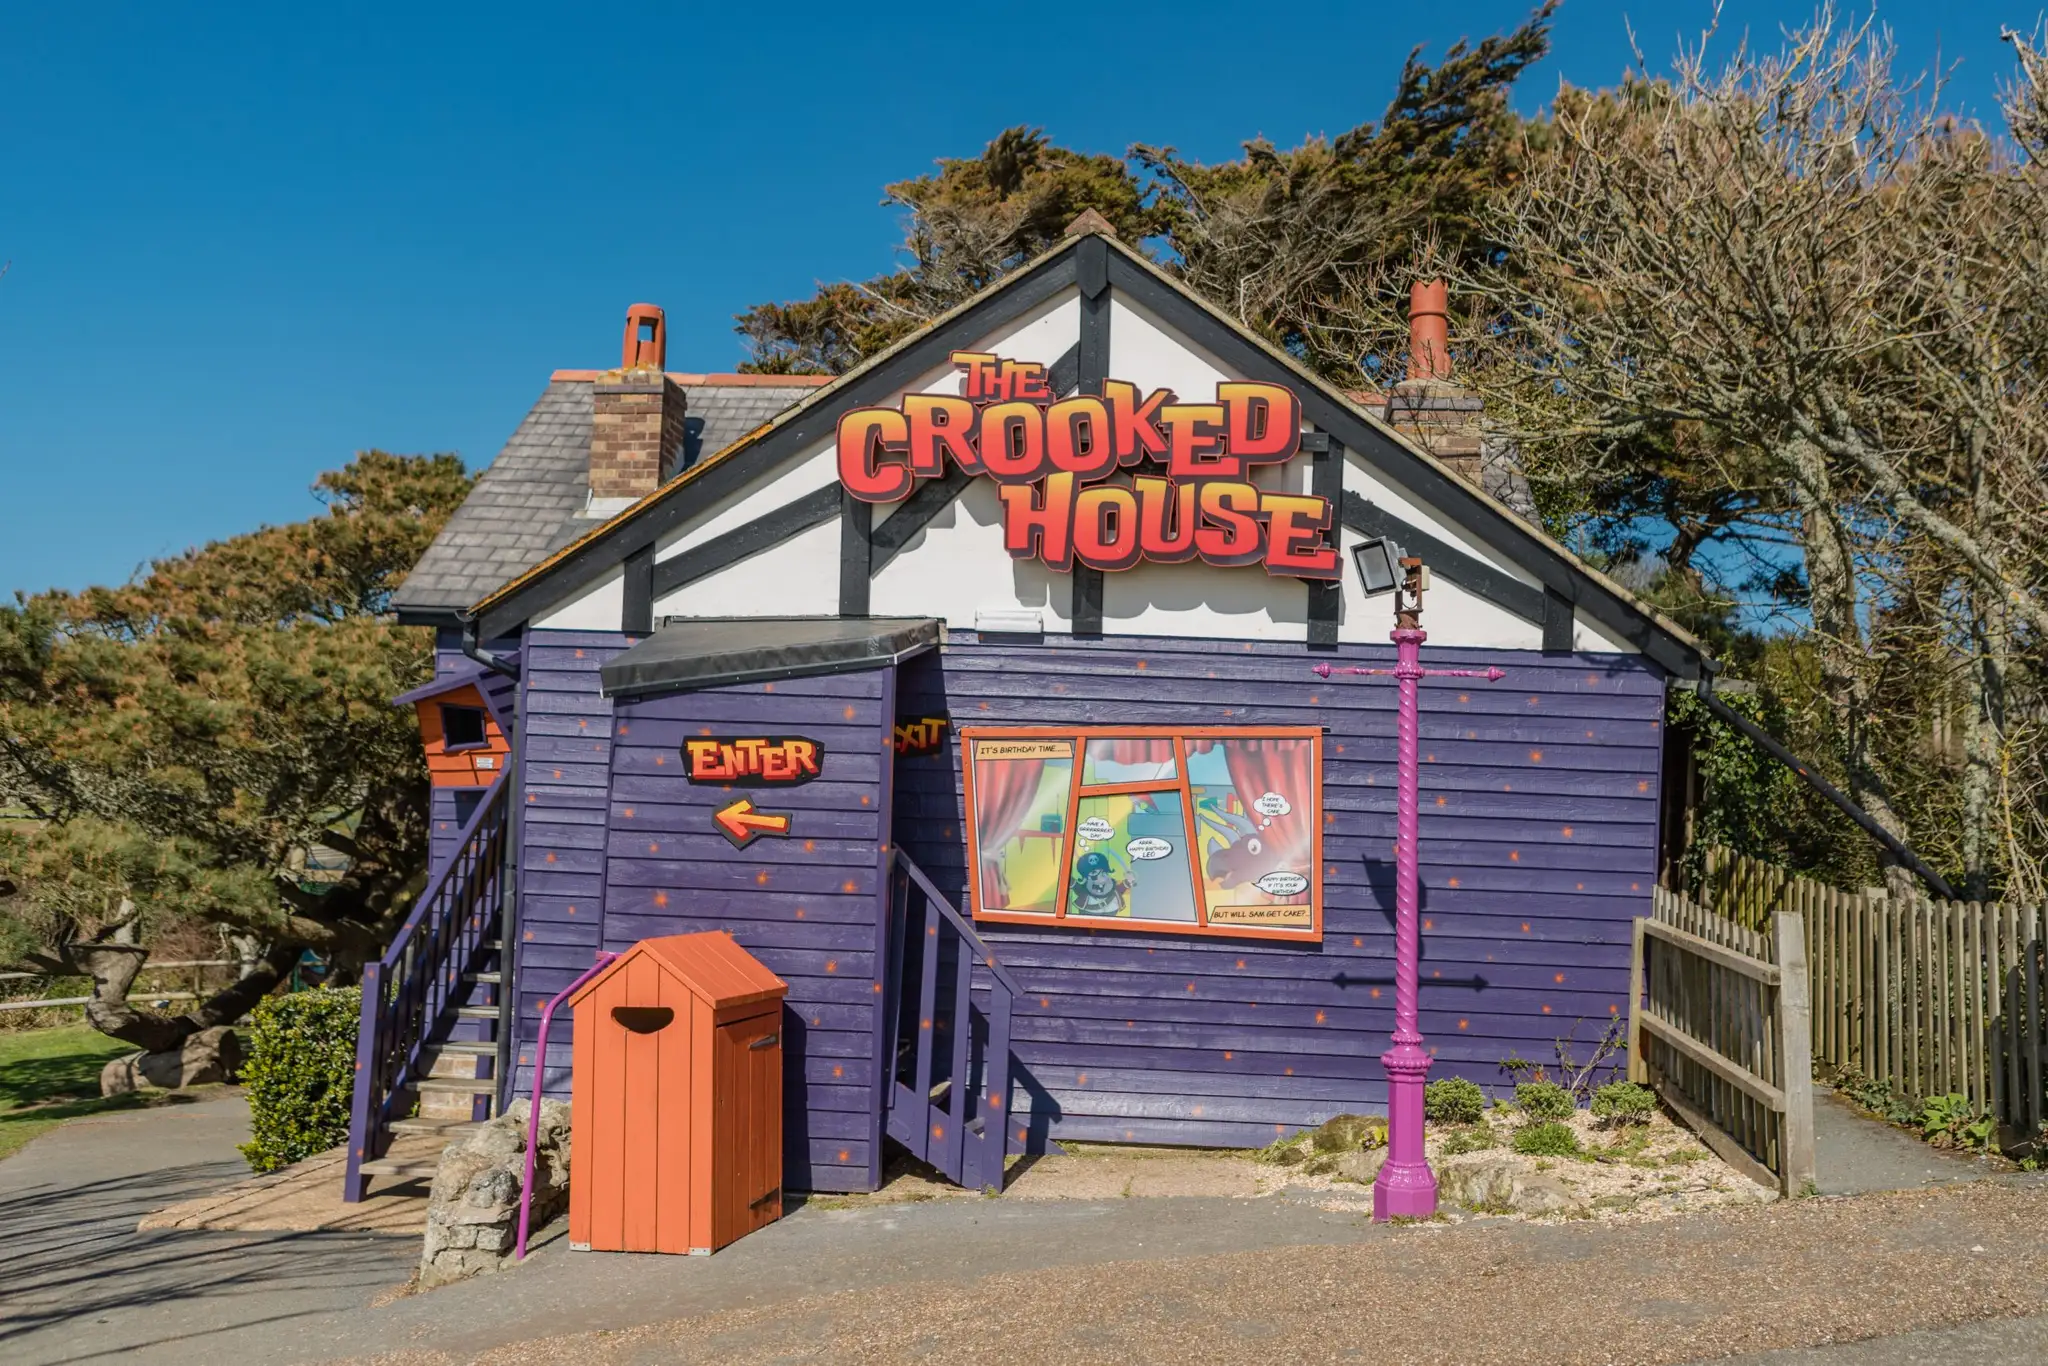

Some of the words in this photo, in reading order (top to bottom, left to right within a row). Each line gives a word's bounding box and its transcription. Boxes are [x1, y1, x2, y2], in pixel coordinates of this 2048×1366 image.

[950, 350, 1049, 400] THE
[836, 378, 1302, 503] CROOKED
[1000, 470, 1343, 579] HOUSE
[895, 717, 947, 754] XIT
[981, 745, 998, 755] IT'S
[1000, 745, 1036, 754] BIRTHDAY
[686, 738, 820, 781] ENTER
[1248, 910, 1265, 918] SAM
[1266, 910, 1281, 918] GET
